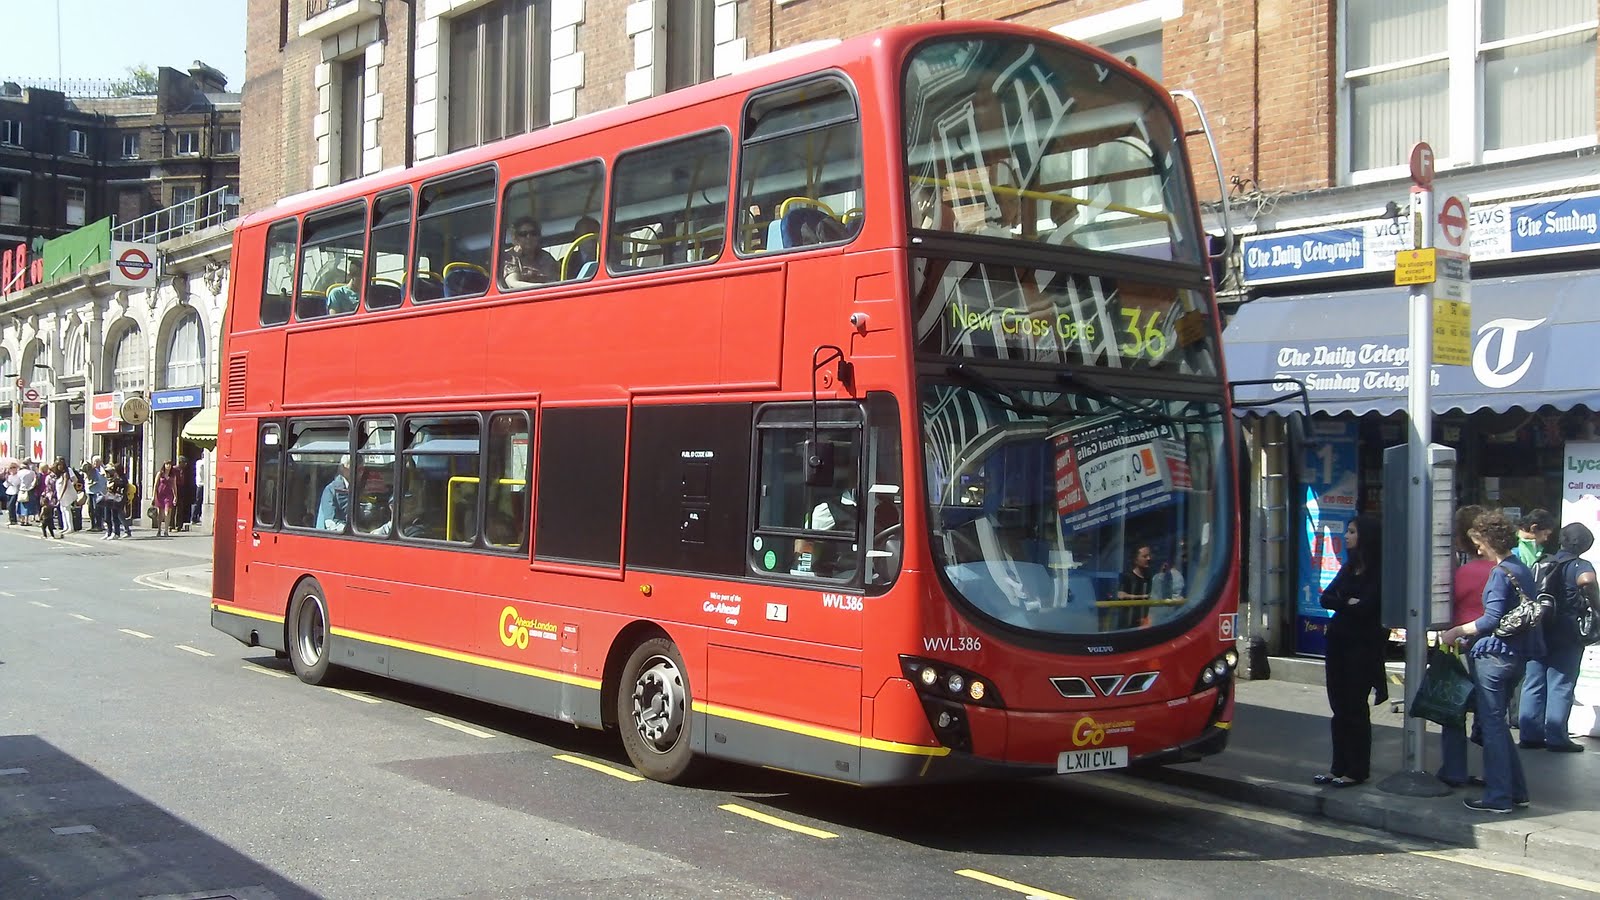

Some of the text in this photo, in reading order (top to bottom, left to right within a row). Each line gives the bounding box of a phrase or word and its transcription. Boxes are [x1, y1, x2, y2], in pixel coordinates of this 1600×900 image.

[1420, 149, 1431, 177] F
[1469, 208, 1504, 227] EWS
[1517, 209, 1597, 238] The Sunday
[1374, 221, 1410, 237] VICT
[1248, 237, 1360, 269] The Daily Telegraph
[952, 303, 1166, 358] New Cross Gate 36
[1277, 346, 1311, 368] The
[1312, 345, 1356, 369] Daily
[1305, 373, 1360, 393] Sunday
[1568, 481, 1584, 490] Call
[1337, 495, 1353, 504] FREE
[1311, 534, 1342, 555] £10
[1311, 556, 1342, 571] FREE
[703, 600, 741, 616] Go-Ahead
[773, 605, 779, 618] 2
[822, 593, 864, 612] WVL386
[499, 605, 529, 650] Go
[923, 636, 982, 652] WVL386
[1087, 645, 1114, 654] VOLVO
[1072, 716, 1105, 747] Go
[1066, 749, 1117, 770] LX11 CVL
